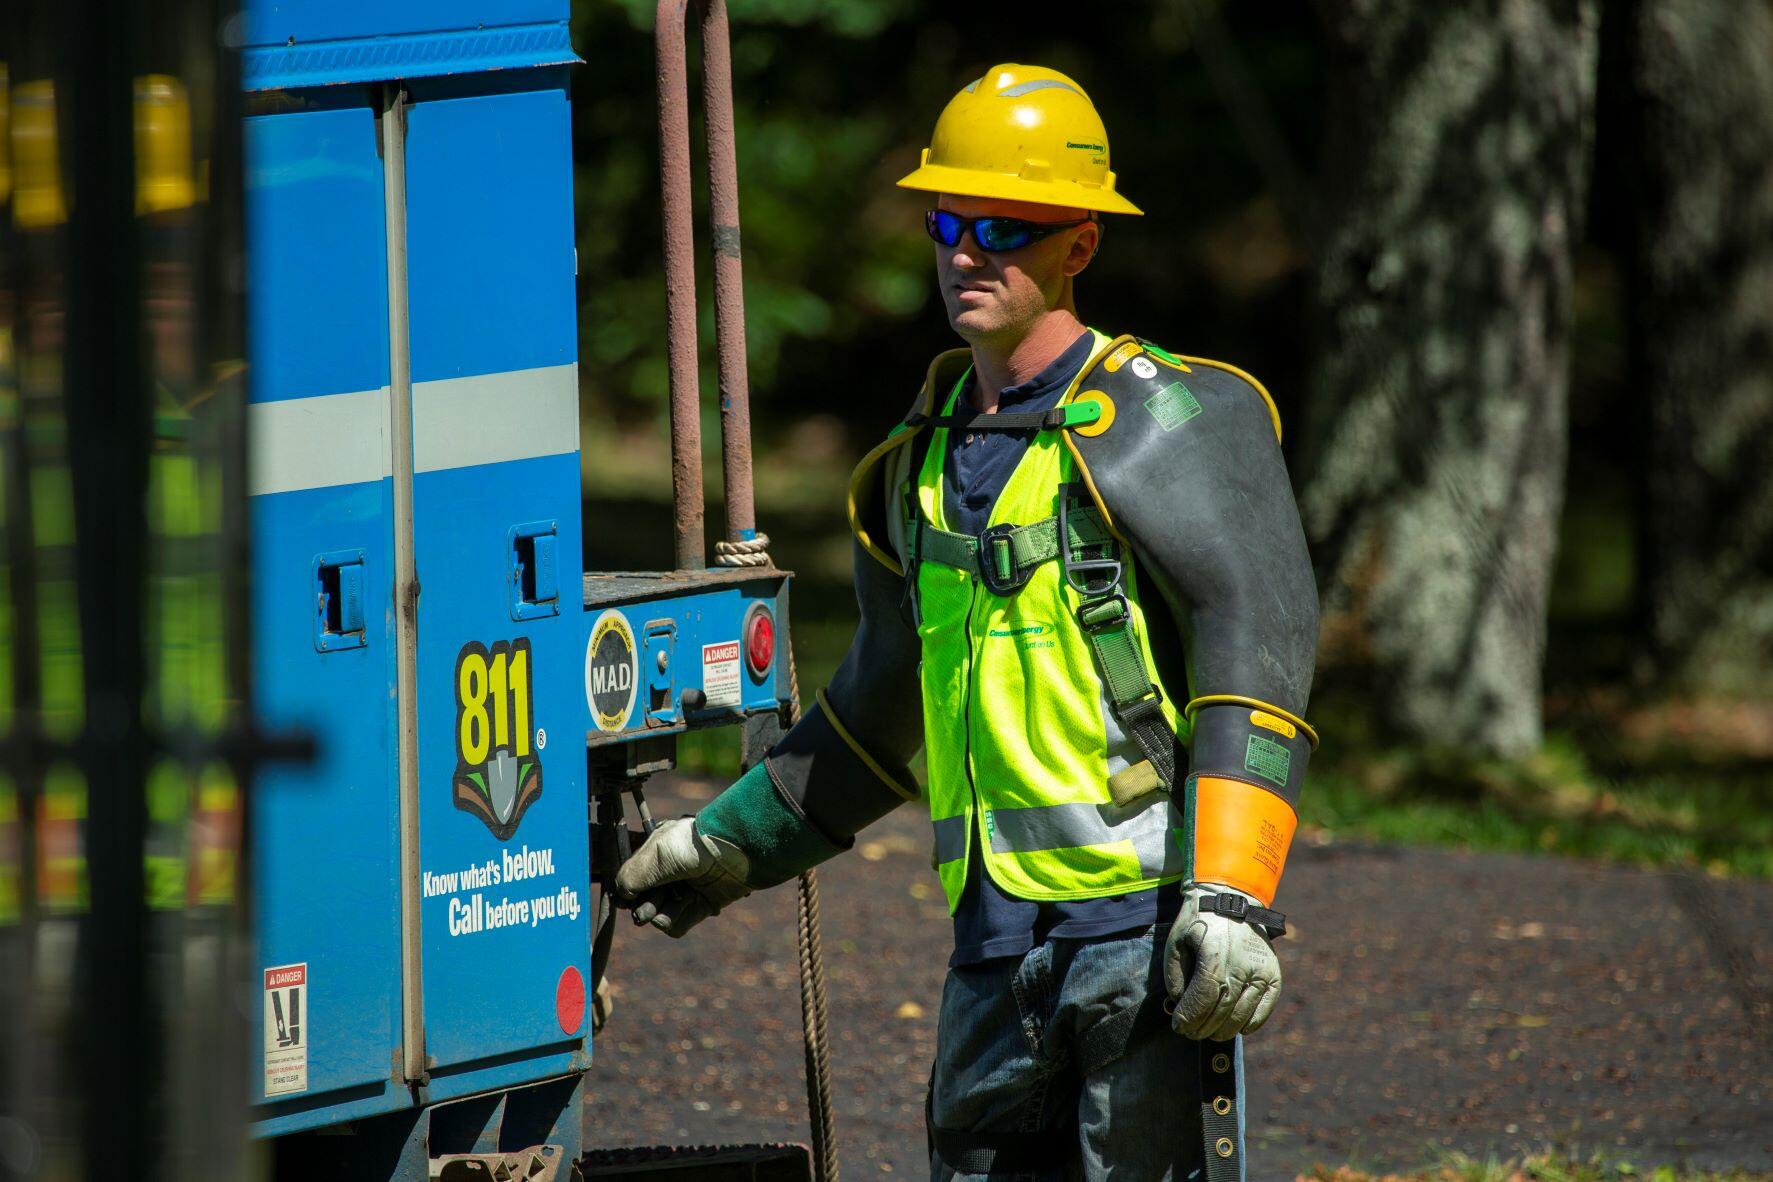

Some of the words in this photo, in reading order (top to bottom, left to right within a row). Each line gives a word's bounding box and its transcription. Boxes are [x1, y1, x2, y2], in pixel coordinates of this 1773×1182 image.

[711, 646, 738, 661] DANGER
[592, 663, 631, 695] M.A.D.
[459, 649, 530, 766] 811
[423, 870, 459, 898] Know
[460, 860, 501, 891] what's
[502, 845, 555, 883] below.
[449, 893, 483, 937] Call
[486, 897, 529, 930] before
[531, 895, 555, 928] you
[557, 886, 581, 921] dig.
[276, 971, 302, 984] DANGER
